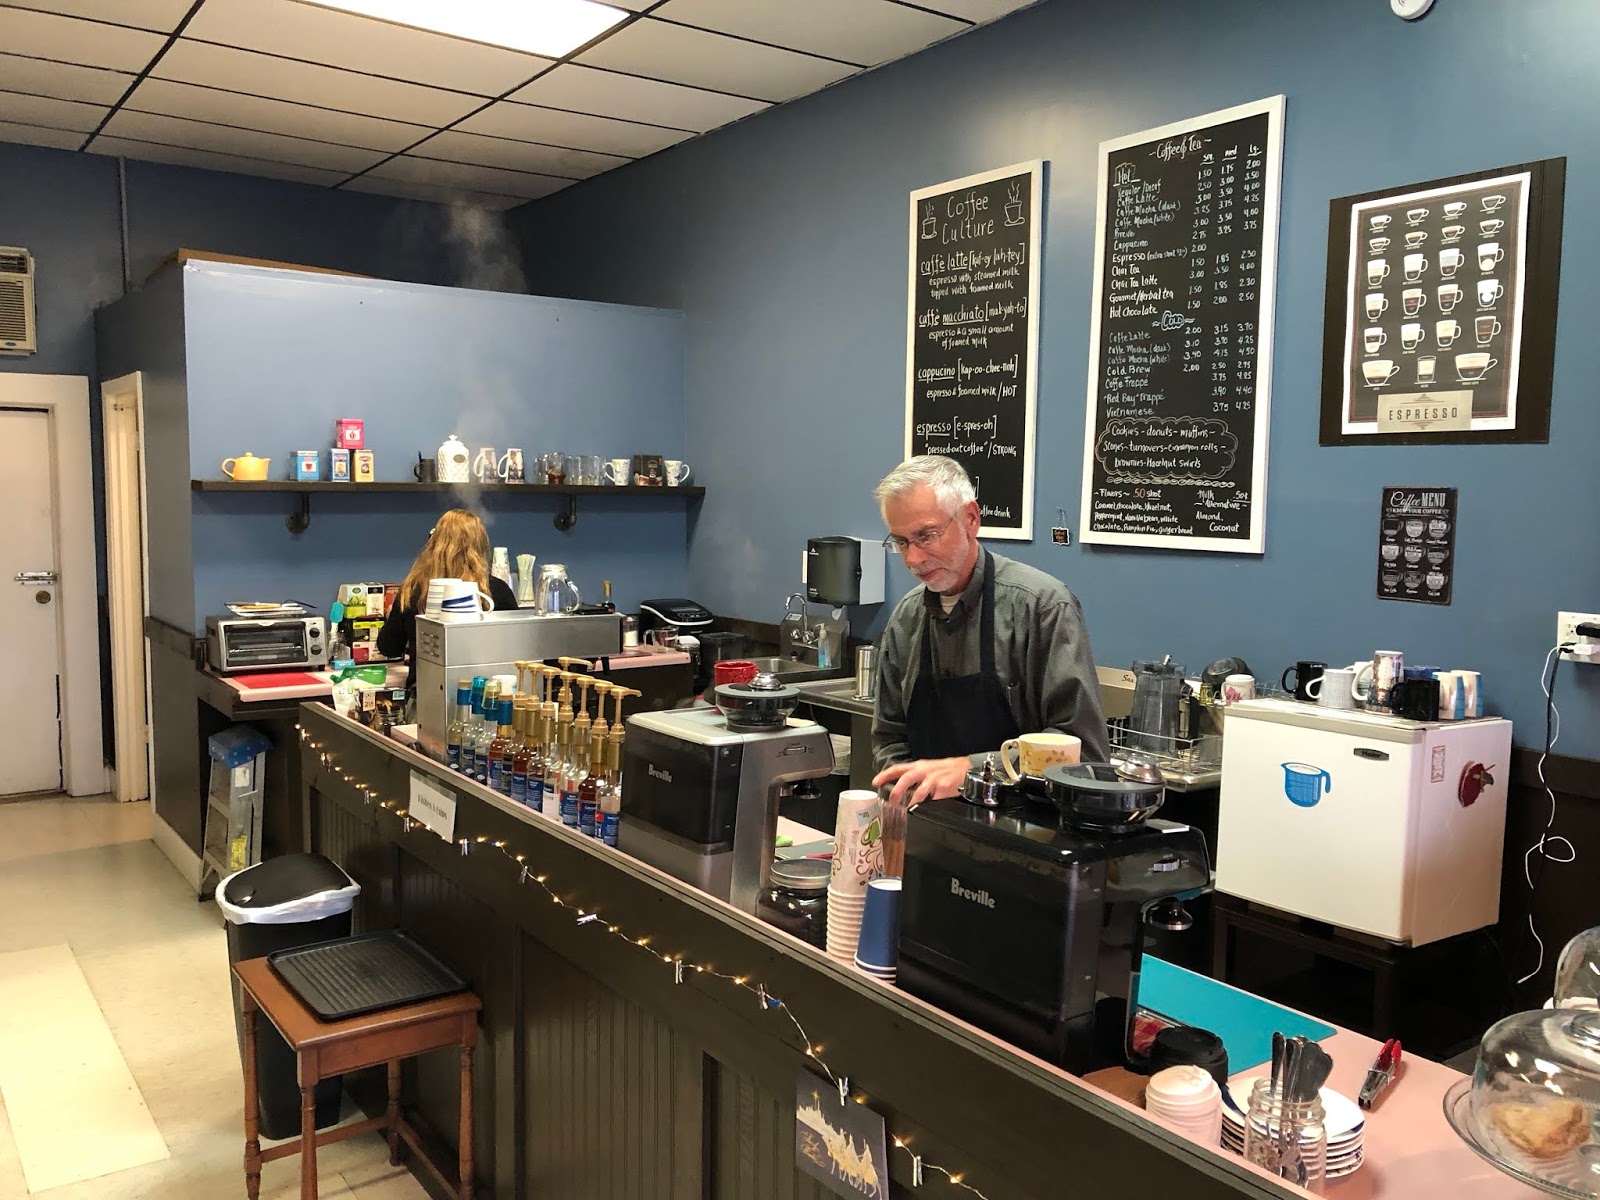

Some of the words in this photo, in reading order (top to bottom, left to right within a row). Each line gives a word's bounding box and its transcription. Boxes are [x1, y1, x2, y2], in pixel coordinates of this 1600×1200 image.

[1156, 140, 1180, 162] Coffee
[1187, 134, 1202, 152] Tea
[1219, 176, 1235, 186] 3.00
[1244, 171, 1260, 181] 3.50
[947, 191, 989, 220] Coffee
[1134, 204, 1157, 215] Mocha
[1218, 187, 1233, 198] 3.50
[1243, 182, 1260, 192] 4.00
[942, 219, 994, 244] Culture
[1114, 227, 1136, 239] Breve
[1243, 208, 1259, 217] 4.00
[947, 251, 968, 271] latte
[1111, 264, 1127, 276] Chai
[1129, 263, 1140, 275] Tea
[1191, 258, 1205, 268] 1.50
[929, 274, 957, 289] espresso
[959, 273, 972, 283] with
[974, 267, 1001, 281] steamed
[1002, 266, 1020, 277] milk
[1111, 278, 1128, 290] Chai
[1129, 277, 1139, 288] Tea
[1141, 274, 1158, 287] Latte
[1189, 270, 1205, 279] 3.00
[930, 286, 949, 300] topped
[951, 284, 967, 295] with
[969, 281, 994, 293] foamed
[995, 279, 1014, 290] milk
[1162, 287, 1174, 300] tea
[1189, 285, 1203, 295] 1.50
[942, 303, 984, 325] macchiato
[1109, 305, 1121, 319] Hot
[1122, 303, 1158, 317] Chocolate
[1187, 300, 1201, 310] 1.50
[1238, 292, 1254, 301] 2.50
[928, 328, 956, 342] espresso
[968, 325, 987, 335] small
[988, 322, 1014, 334] amount
[918, 363, 956, 384] cappucino
[1106, 365, 1127, 376] Cold
[1128, 365, 1151, 374] Brew
[926, 388, 952, 402] espresso
[957, 383, 980, 398] foamed
[981, 385, 997, 397] milk
[1106, 407, 1155, 418] Vietnamese
[1388, 407, 1458, 421] ESPRESSO
[916, 422, 952, 441] espresso
[1200, 442, 1218, 453] rolls
[1179, 456, 1201, 468] swirls
[1390, 490, 1420, 512] Coffee
[1421, 492, 1446, 508] MENU
[979, 504, 993, 518] offee
[994, 505, 1011, 519] drink
[1209, 521, 1240, 533] Coconut
[648, 763, 672, 783] Breville
[951, 877, 996, 909] Breville
